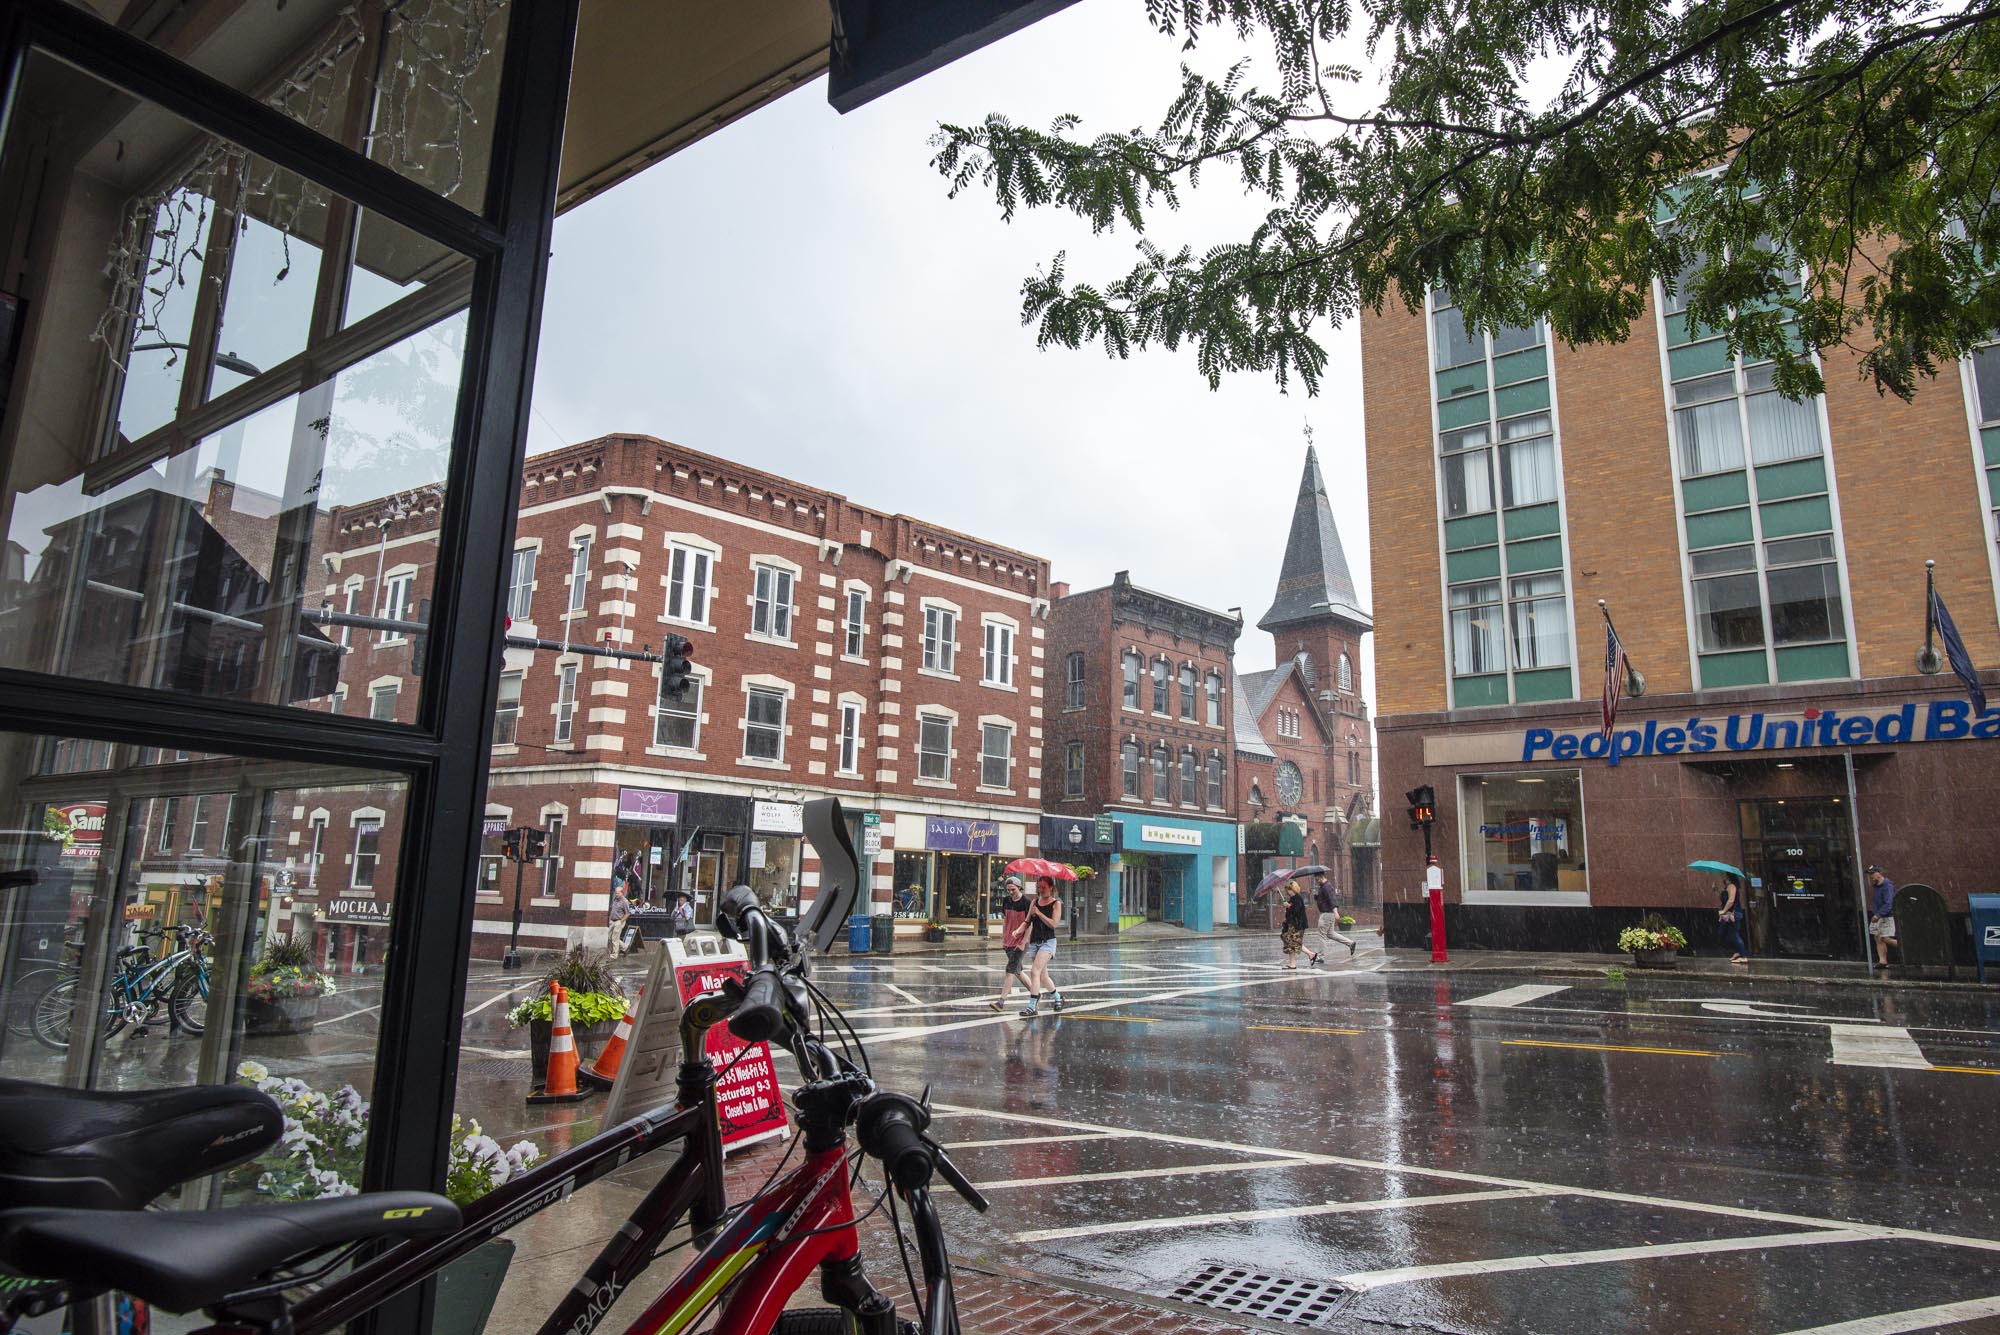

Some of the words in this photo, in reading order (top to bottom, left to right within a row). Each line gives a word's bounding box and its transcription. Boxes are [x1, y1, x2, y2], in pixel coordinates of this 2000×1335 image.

[1522, 716, 1718, 767] People's
[1724, 703, 1916, 750] United
[483, 822, 506, 836] APPAREL
[931, 824, 963, 835] SALON
[328, 900, 379, 916] MOCHA
[701, 974, 732, 991] Mai
[735, 1063, 759, 1082] Wed-Fri
[758, 1061, 769, 1077] 9-5
[717, 1085, 755, 1103] Saturday
[756, 1079, 771, 1093] 9-3
[725, 1102, 744, 1119] Closed
[742, 1100, 753, 1115] Sun
[753, 1097, 758, 1112] &
[757, 1096, 769, 1110] Mon
[383, 1206, 432, 1220] GT
[491, 1199, 543, 1235] EDGEWOOD
[544, 1189, 560, 1205] LX
[566, 1270, 623, 1335] BACK
